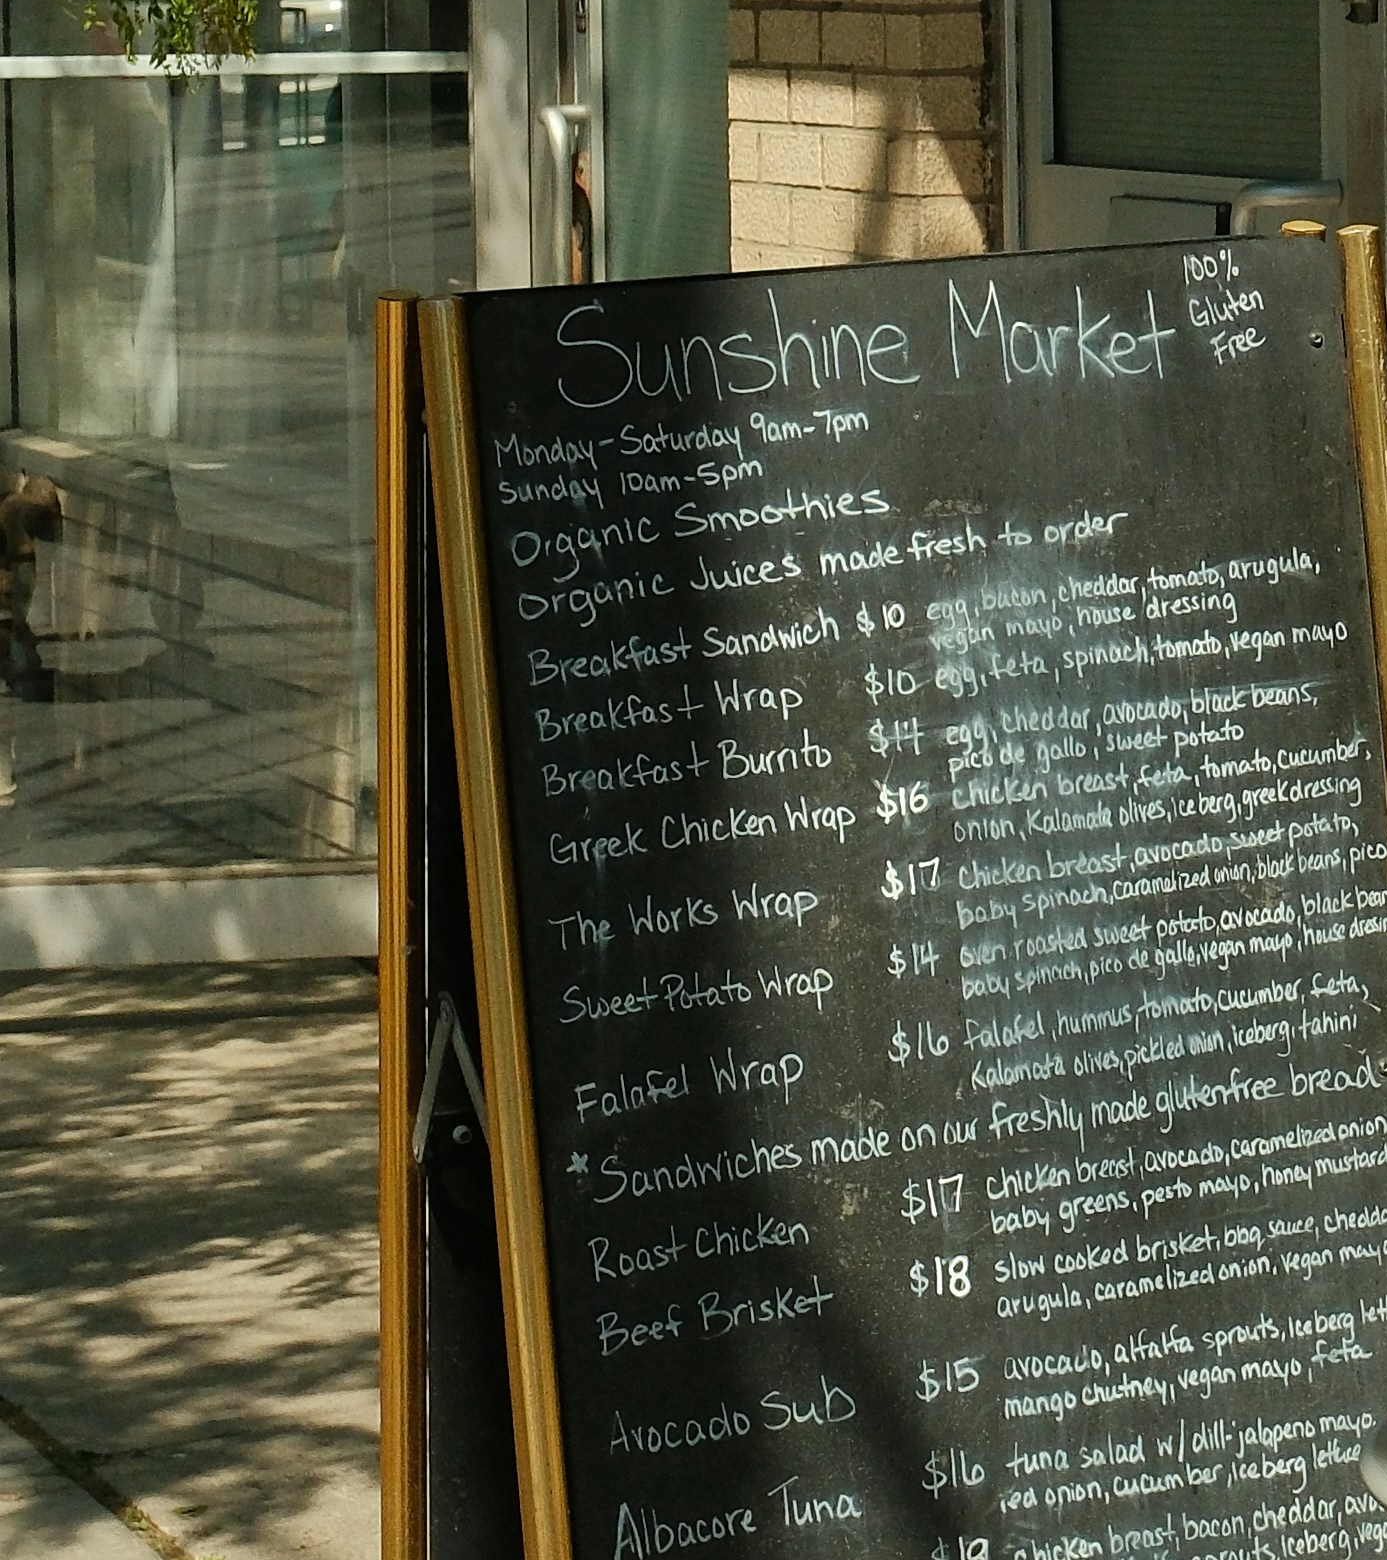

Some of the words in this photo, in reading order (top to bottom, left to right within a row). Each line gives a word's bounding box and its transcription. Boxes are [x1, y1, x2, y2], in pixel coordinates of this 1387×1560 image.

[1182, 246, 1240, 287] 100%
[1186, 288, 1265, 327] Gluten
[555, 287, 921, 408] Sunshine
[947, 277, 1176, 385] Market
[1208, 326, 1267, 366] Free
[493, 422, 744, 471] Monday-Saturday
[748, 408, 869, 444] 9am-7pm
[497, 473, 604, 510] Sunday
[619, 458, 763, 495] 10am-5pm
[509, 515, 660, 584] Organic
[673, 486, 890, 537] Smoothies
[517, 570, 675, 628] Organic
[689, 544, 805, 591] Juices
[818, 536, 904, 577] made
[905, 512, 987, 562] fresh
[996, 516, 1032, 549] to
[1043, 505, 1129, 547] order
[526, 625, 692, 686] Breakfast
[700, 602, 840, 658] Sandwich
[533, 683, 704, 742] Breakfast
[712, 673, 807, 723] Wrap
[863, 661, 920, 706] $10
[540, 739, 710, 797] Breakfast
[549, 821, 648, 866] Greek
[660, 806, 778, 849] Chicken
[782, 794, 856, 844] Wrap
[870, 778, 934, 827] $16
[547, 909, 615, 951] The
[627, 893, 719, 936] Works
[730, 881, 823, 928] Wrap
[880, 855, 946, 904] $17
[558, 975, 658, 1024] Sweet
[658, 968, 752, 1012] Potato
[756, 956, 834, 1016] Wrap
[886, 938, 940, 981] $14
[573, 1062, 689, 1124] Falafel
[708, 1045, 804, 1113] Wrap
[886, 1018, 950, 1069] $16
[592, 1137, 803, 1203] Sandwiches
[810, 1122, 892, 1170] made
[896, 1122, 936, 1152] on
[942, 1116, 978, 1145] our
[987, 1092, 1085, 1160] freshly
[1090, 1088, 1152, 1129] made
[1288, 1048, 1383, 1097] bread
[587, 1224, 687, 1283] Roast
[900, 1172, 970, 1225] $17
[989, 1196, 1052, 1246] baby
[1058, 1189, 1138, 1234] greens,
[1139, 1174, 1192, 1221] pesto
[1260, 1162, 1313, 1191] honey
[595, 1302, 683, 1356] Beef
[696, 1273, 834, 1340] Brisket
[908, 1254, 972, 1299] $18
[993, 1249, 1045, 1283] slow
[1053, 1237, 1129, 1274] cooked
[1223, 1223, 1266, 1256] bbq
[609, 1401, 751, 1455] Avocado
[759, 1373, 856, 1431] Sub
[914, 1353, 983, 1403] $15
[766, 1466, 865, 1530] Tuna
[920, 1442, 985, 1500] $16
